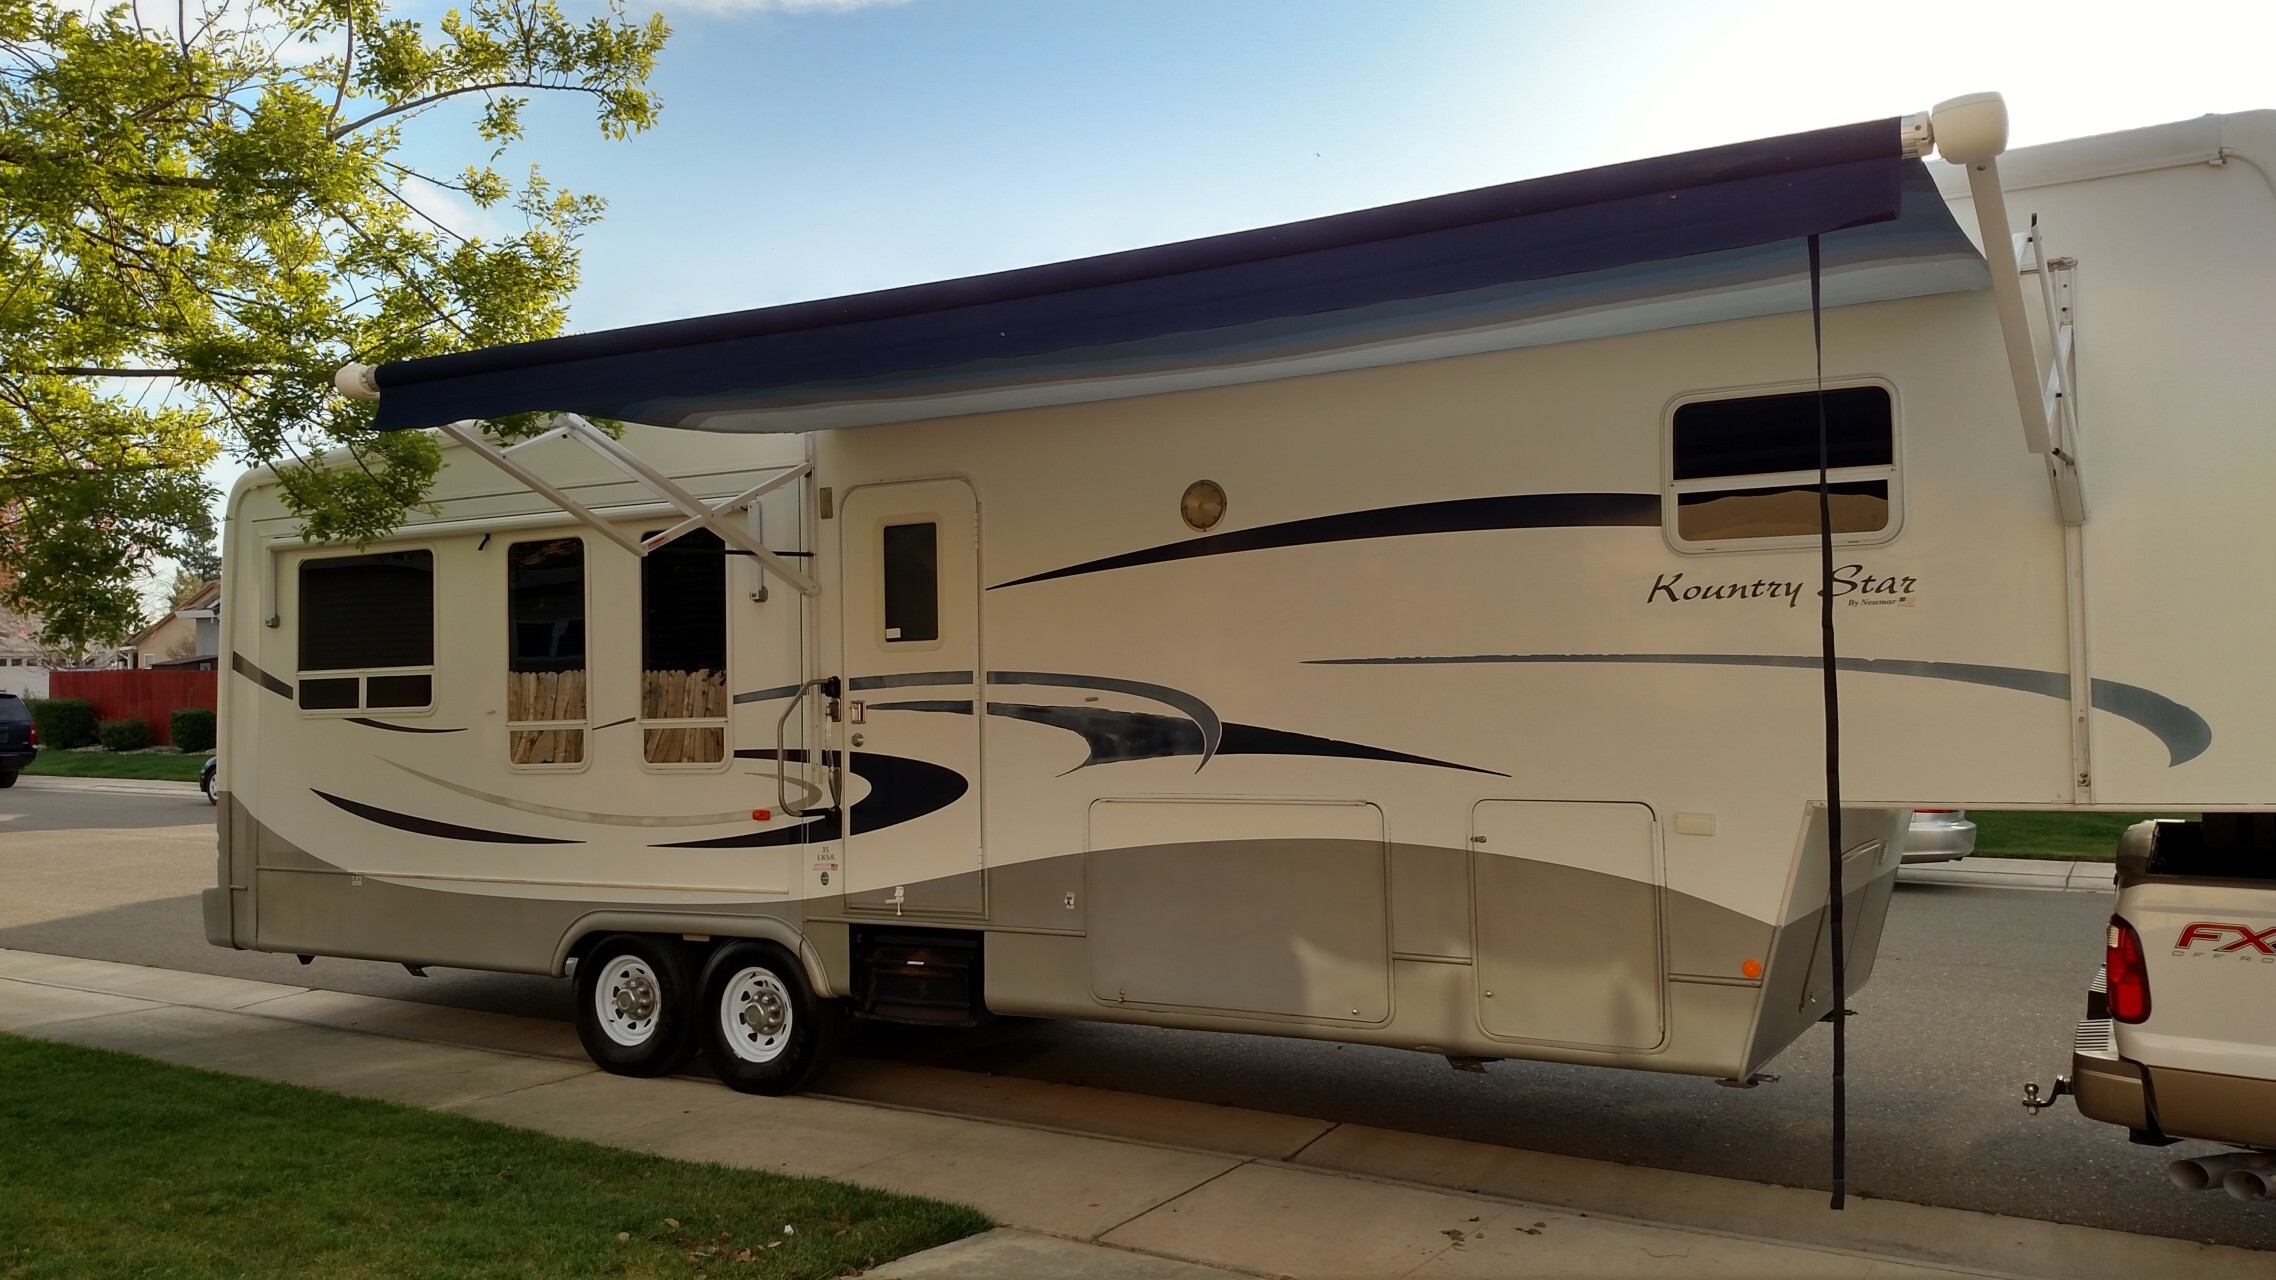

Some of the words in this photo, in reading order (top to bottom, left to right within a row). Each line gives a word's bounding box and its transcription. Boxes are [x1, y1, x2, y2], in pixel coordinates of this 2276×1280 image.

[1646, 572, 1803, 608] Kountry
[1817, 564, 1917, 597] Star
[1848, 599, 1859, 607] By
[2175, 922, 2276, 956] FX
[2171, 950, 2225, 959] OFF
